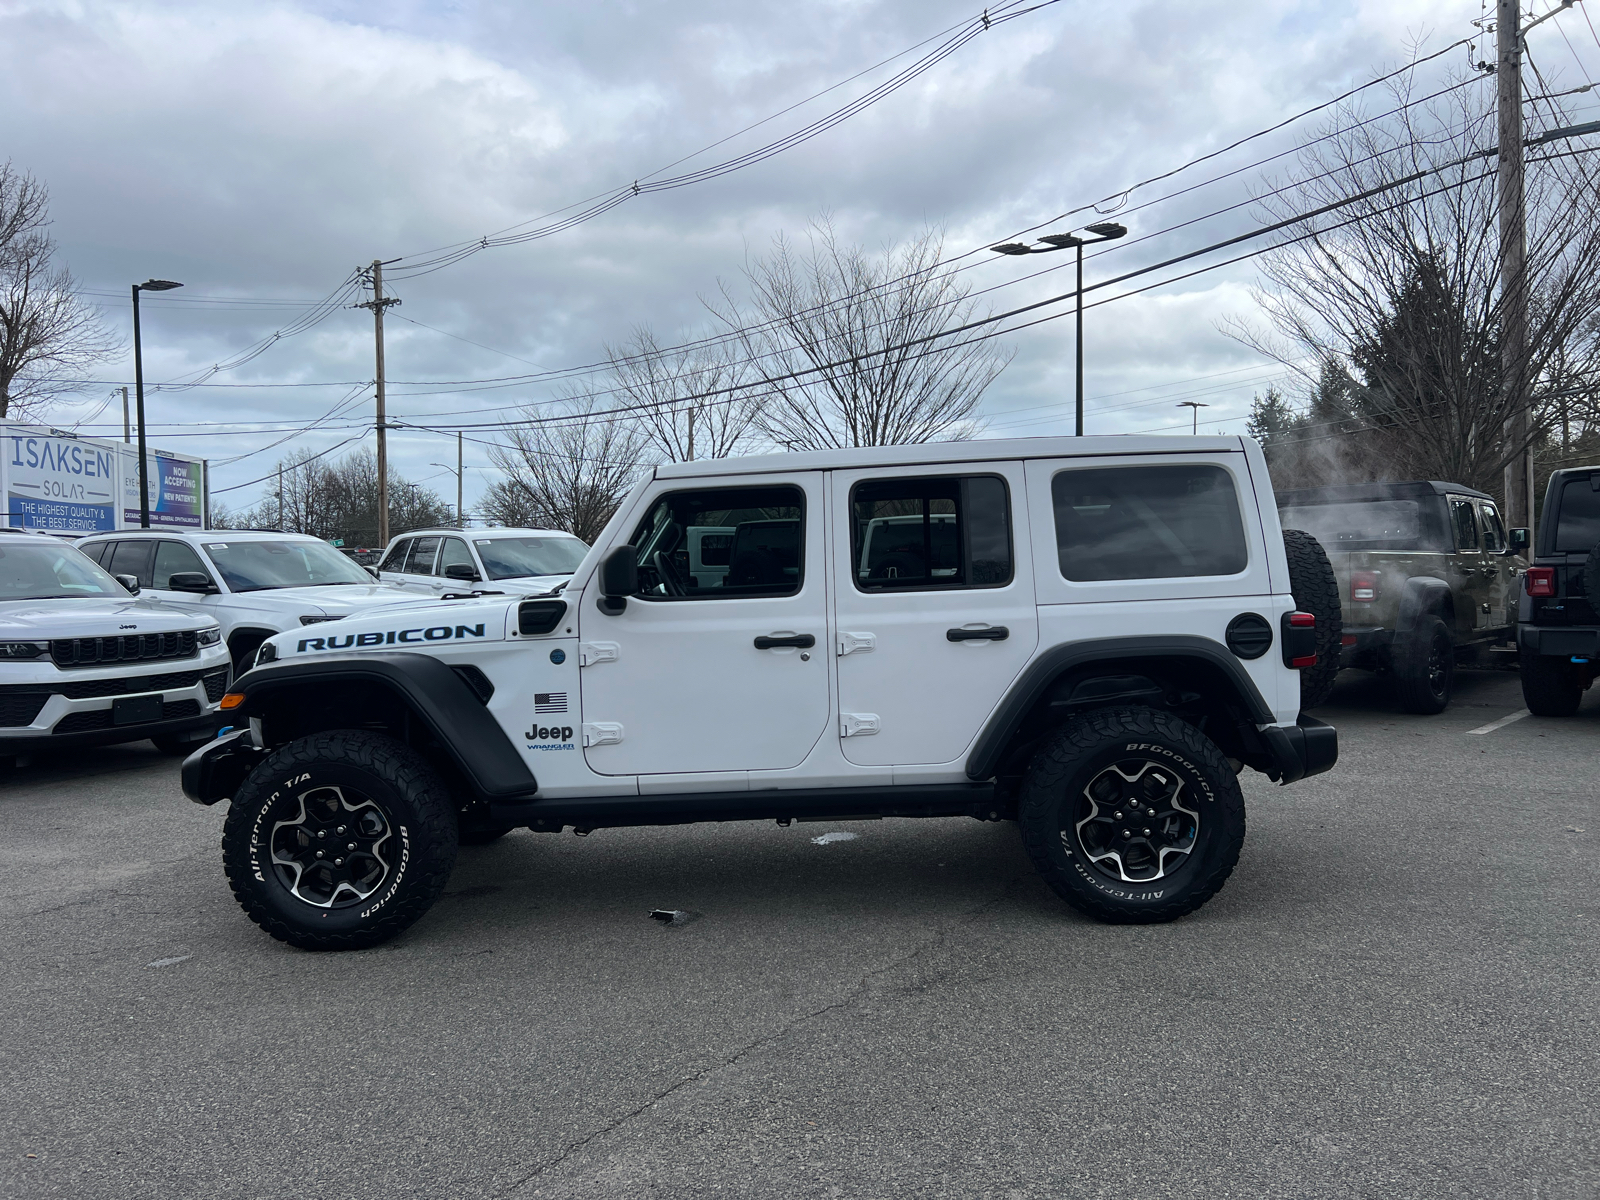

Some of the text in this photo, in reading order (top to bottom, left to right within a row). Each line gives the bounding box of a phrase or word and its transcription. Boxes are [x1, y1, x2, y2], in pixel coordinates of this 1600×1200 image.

[11, 436, 110, 479] ISAKSEN
[173, 466, 188, 477] NOW
[43, 480, 85, 499] SOLAR
[125, 477, 135, 487] EYE
[164, 475, 196, 489] ACCEPTING
[164, 492, 175, 501] NEW
[20, 502, 105, 519] THE HIGHEST QUALITY &
[31, 516, 97, 531] THE BEST SERVICE
[297, 623, 486, 652] RUBICON
[525, 723, 574, 742] Jeep
[1125, 742, 1215, 802] BFGoodrich
[250, 772, 312, 882] All-Terrain T/A
[360, 825, 410, 919] BFGoodrich
[1060, 829, 1165, 900] All-Terrain T/A
